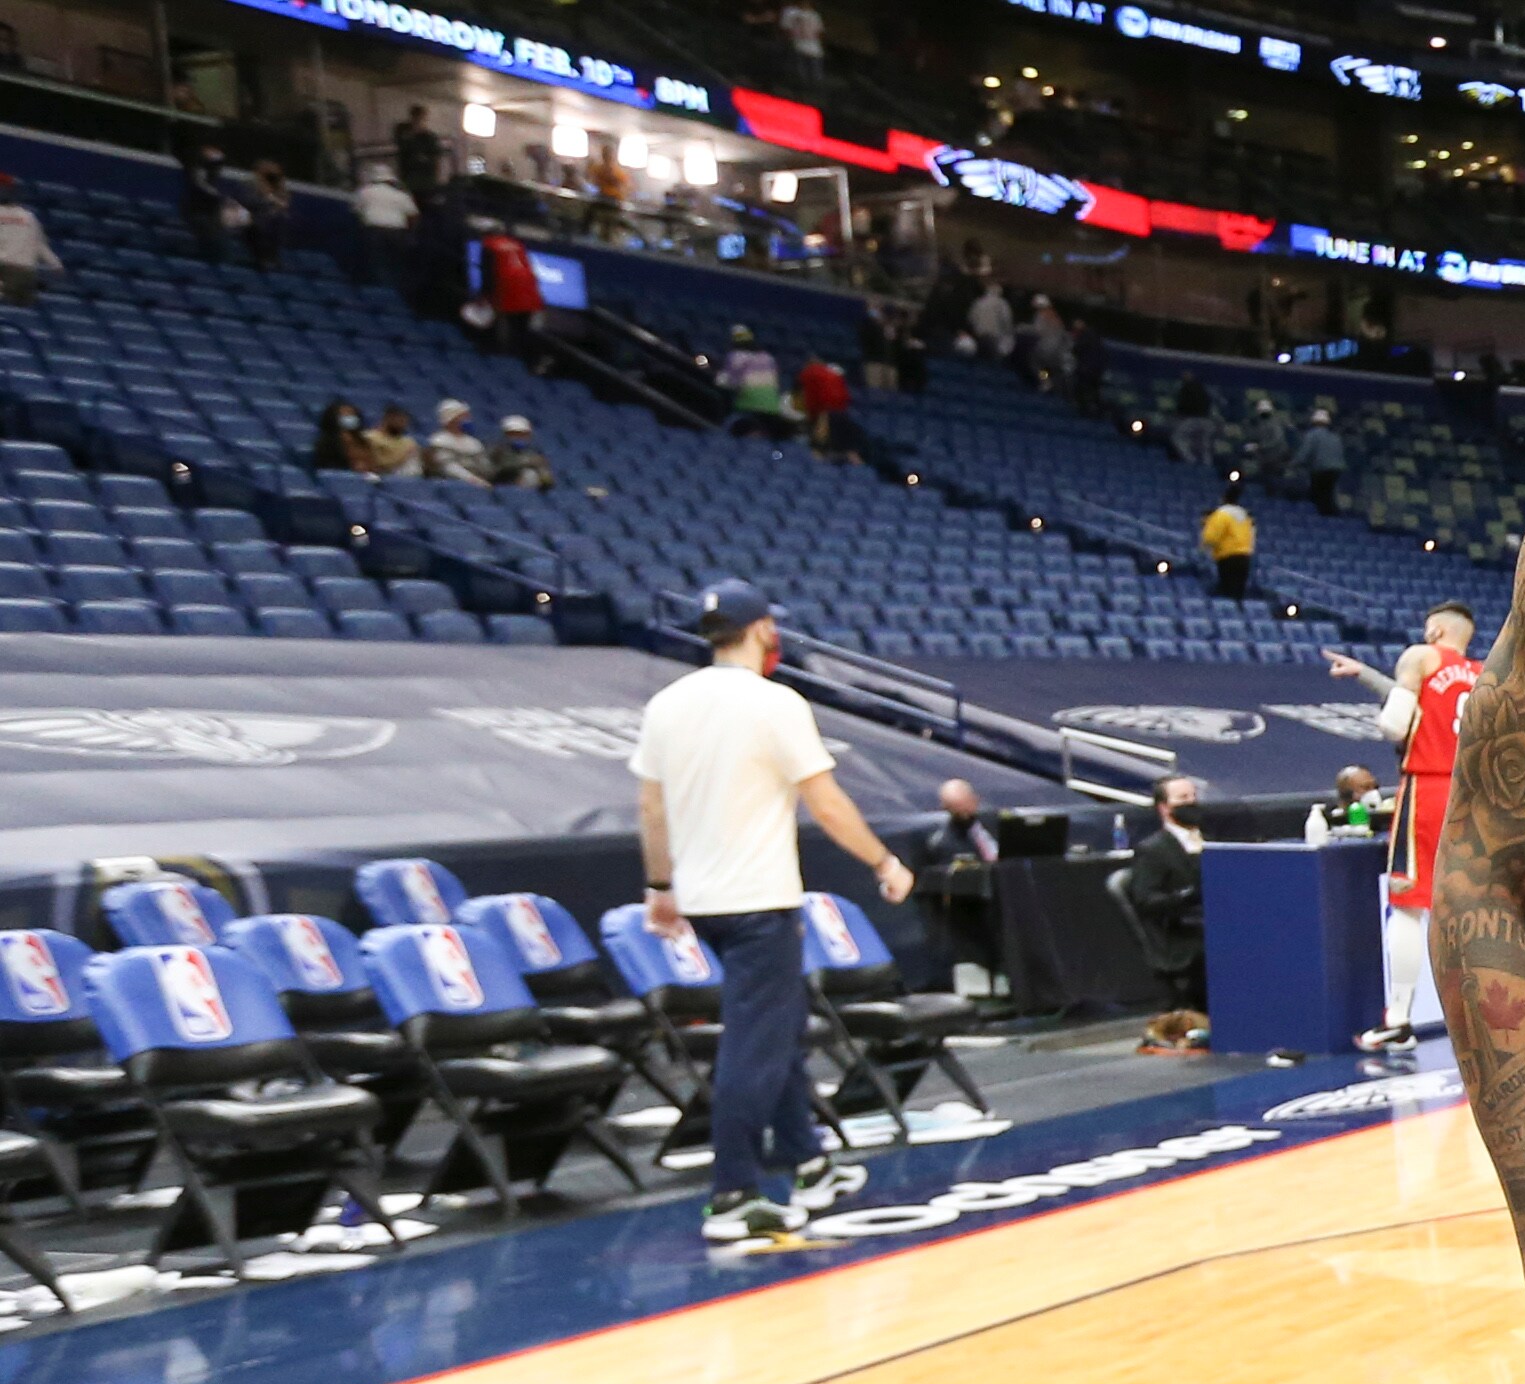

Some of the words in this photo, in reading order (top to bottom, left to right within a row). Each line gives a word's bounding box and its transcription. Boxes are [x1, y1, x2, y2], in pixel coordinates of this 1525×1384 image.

[514, 37, 579, 78] FEB.
[1313, 235, 1371, 266] TUNE
[1398, 249, 1428, 273] AT
